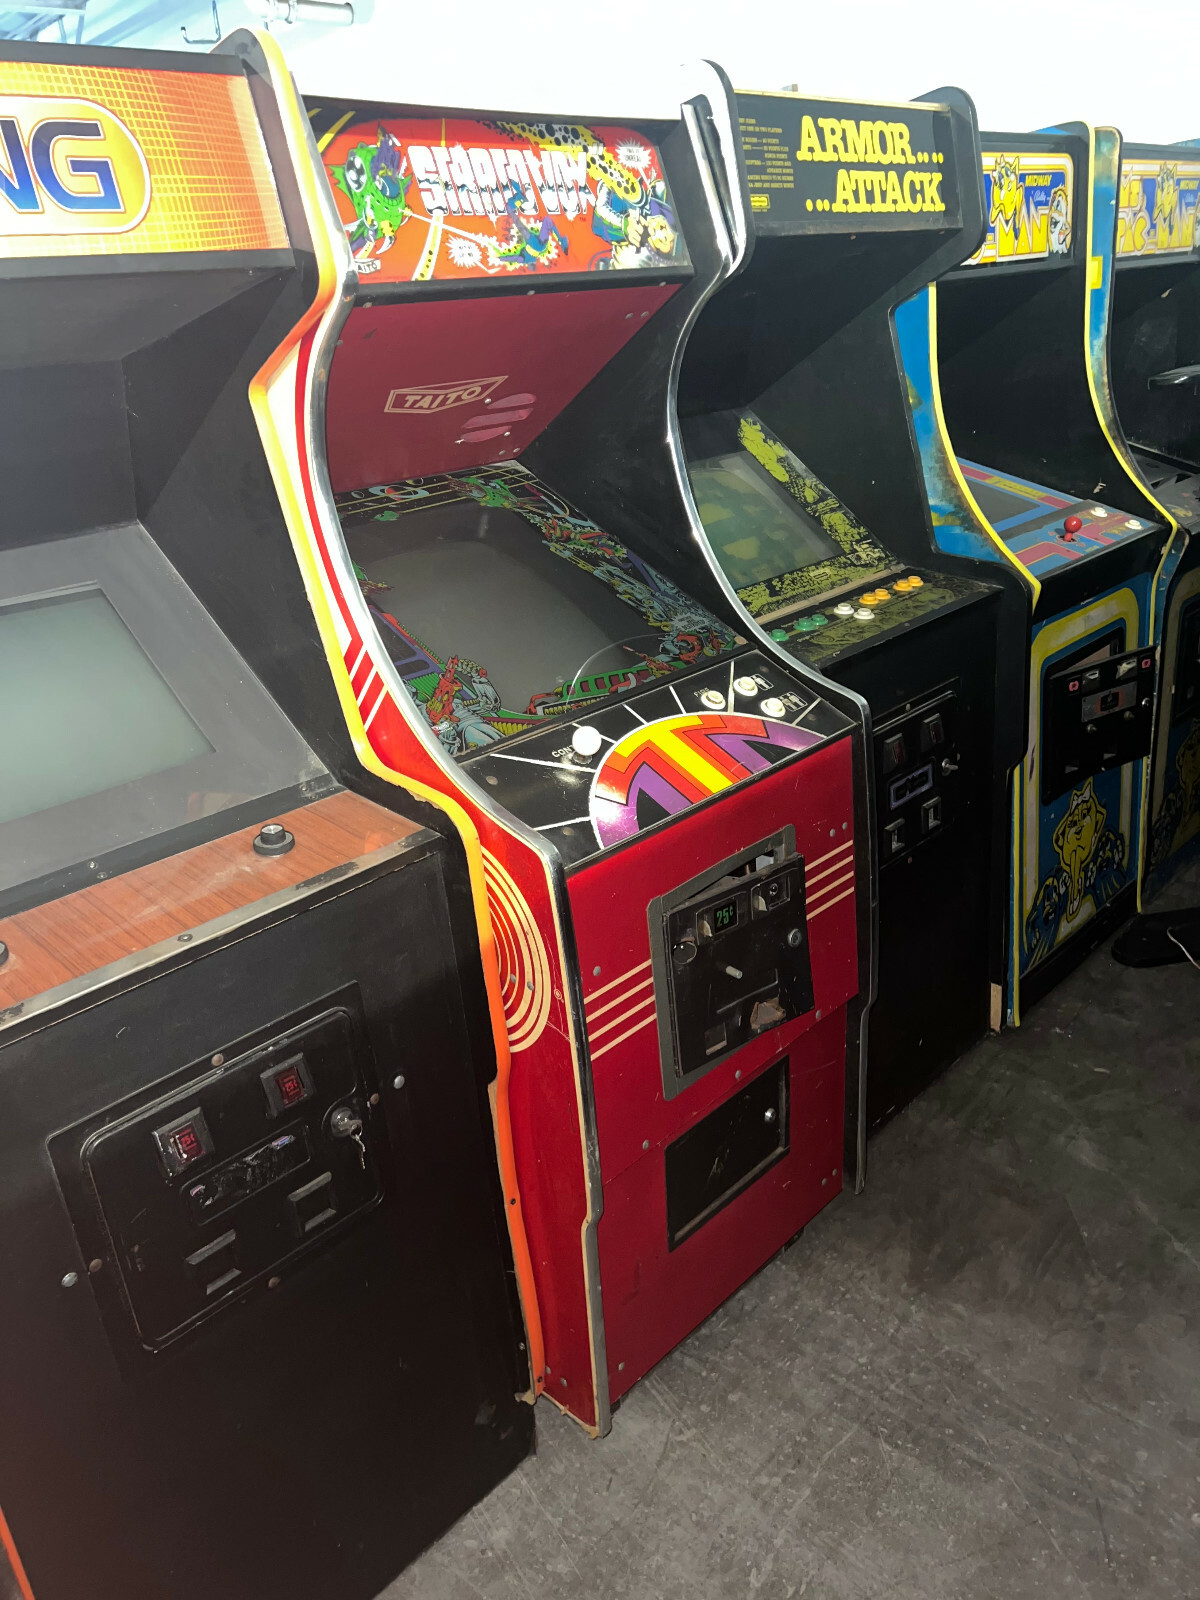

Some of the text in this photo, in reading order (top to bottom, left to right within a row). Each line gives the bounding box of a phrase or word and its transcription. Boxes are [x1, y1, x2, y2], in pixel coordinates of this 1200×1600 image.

[1025, 174, 1053, 187] MIDWAY
[355, 261, 378, 273] AITO
[403, 386, 482, 409] TAITO
